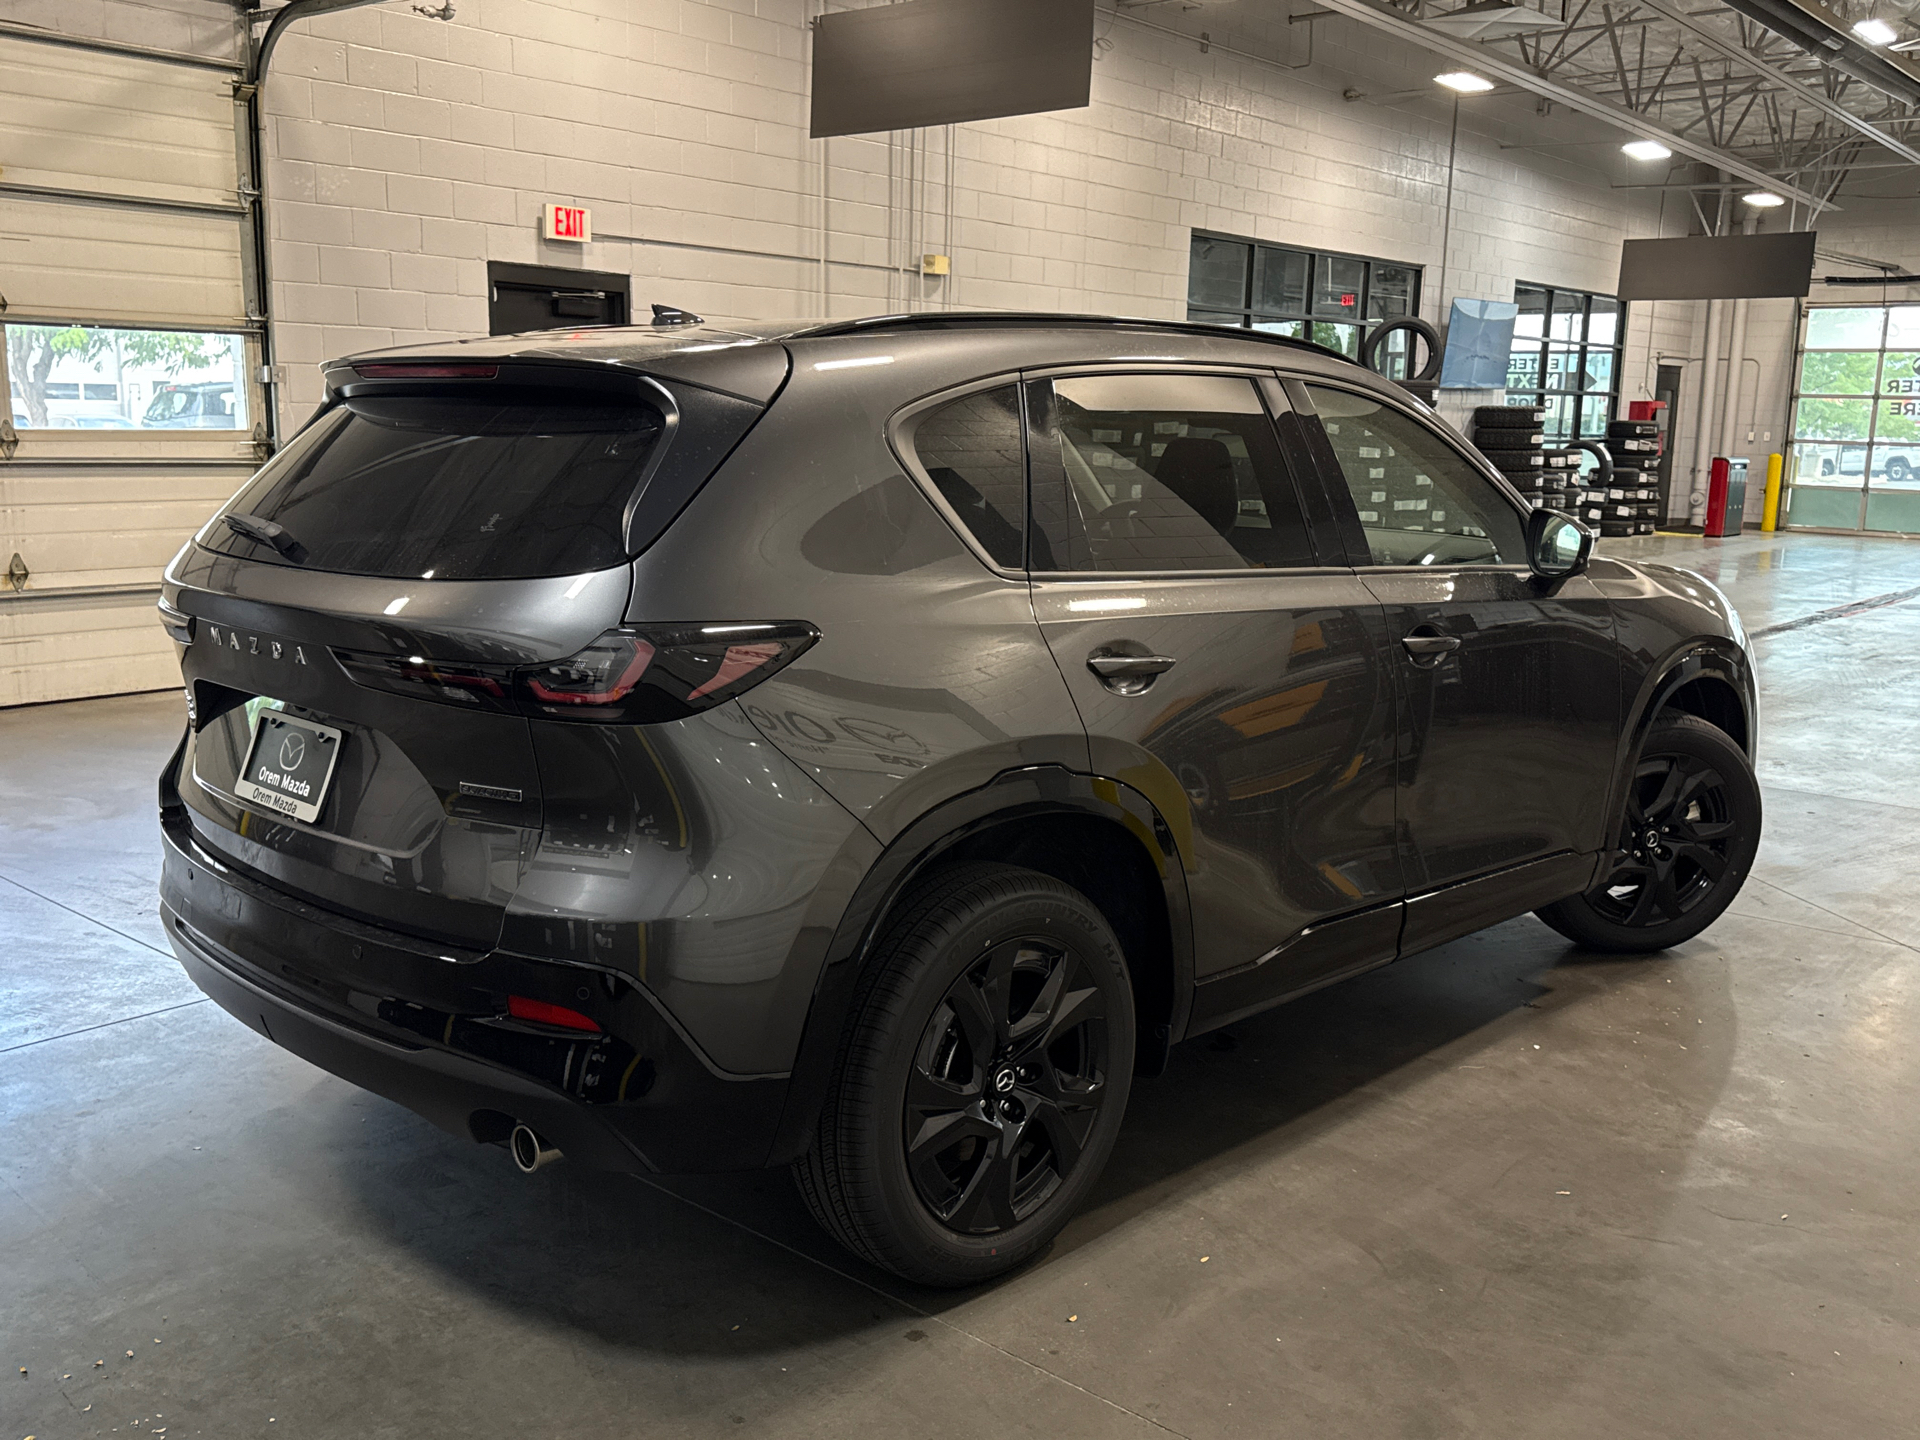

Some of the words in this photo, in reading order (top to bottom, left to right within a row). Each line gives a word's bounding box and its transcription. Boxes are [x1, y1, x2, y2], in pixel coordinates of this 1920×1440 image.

[554, 206, 586, 238] EXIT
[210, 626, 307, 666] MAZDA
[258, 765, 280, 787] Orem
[280, 773, 311, 797] Mazda
[252, 787, 272, 805] Orem
[272, 794, 298, 814] Mazda
[1015, 902, 1098, 933] COUNTRY
[1102, 943, 1125, 981] H/T
